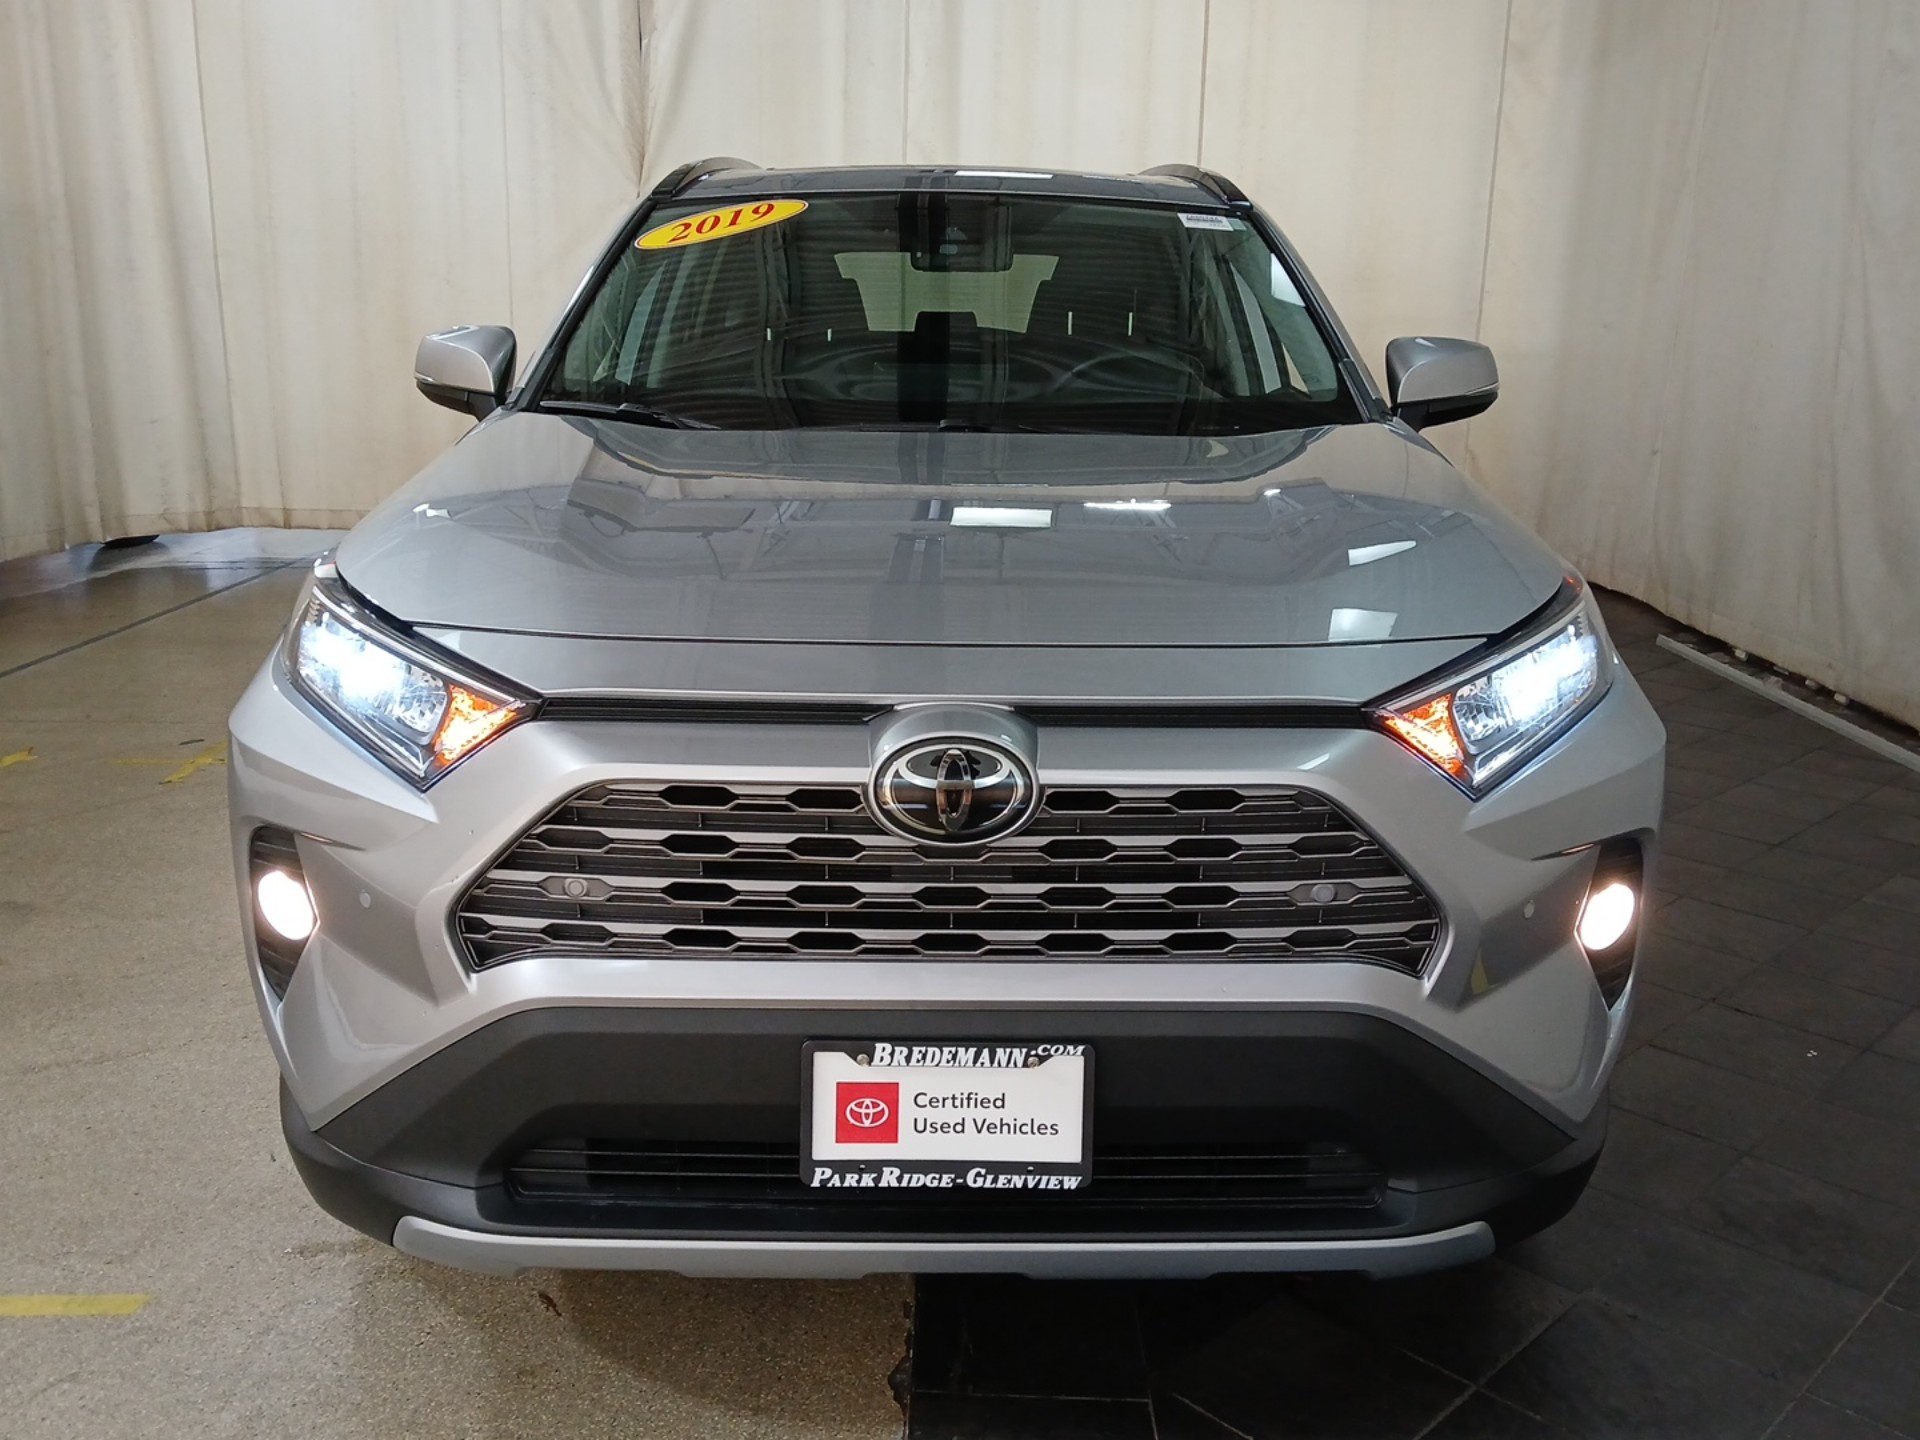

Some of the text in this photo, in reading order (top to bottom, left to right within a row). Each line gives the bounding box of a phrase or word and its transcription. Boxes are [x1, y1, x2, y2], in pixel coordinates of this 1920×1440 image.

[667, 203, 776, 243] 2019
[913, 1091, 1006, 1109] Certified
[913, 1117, 1059, 1136] Used Vehicles
[810, 1167, 878, 1188] PARK
